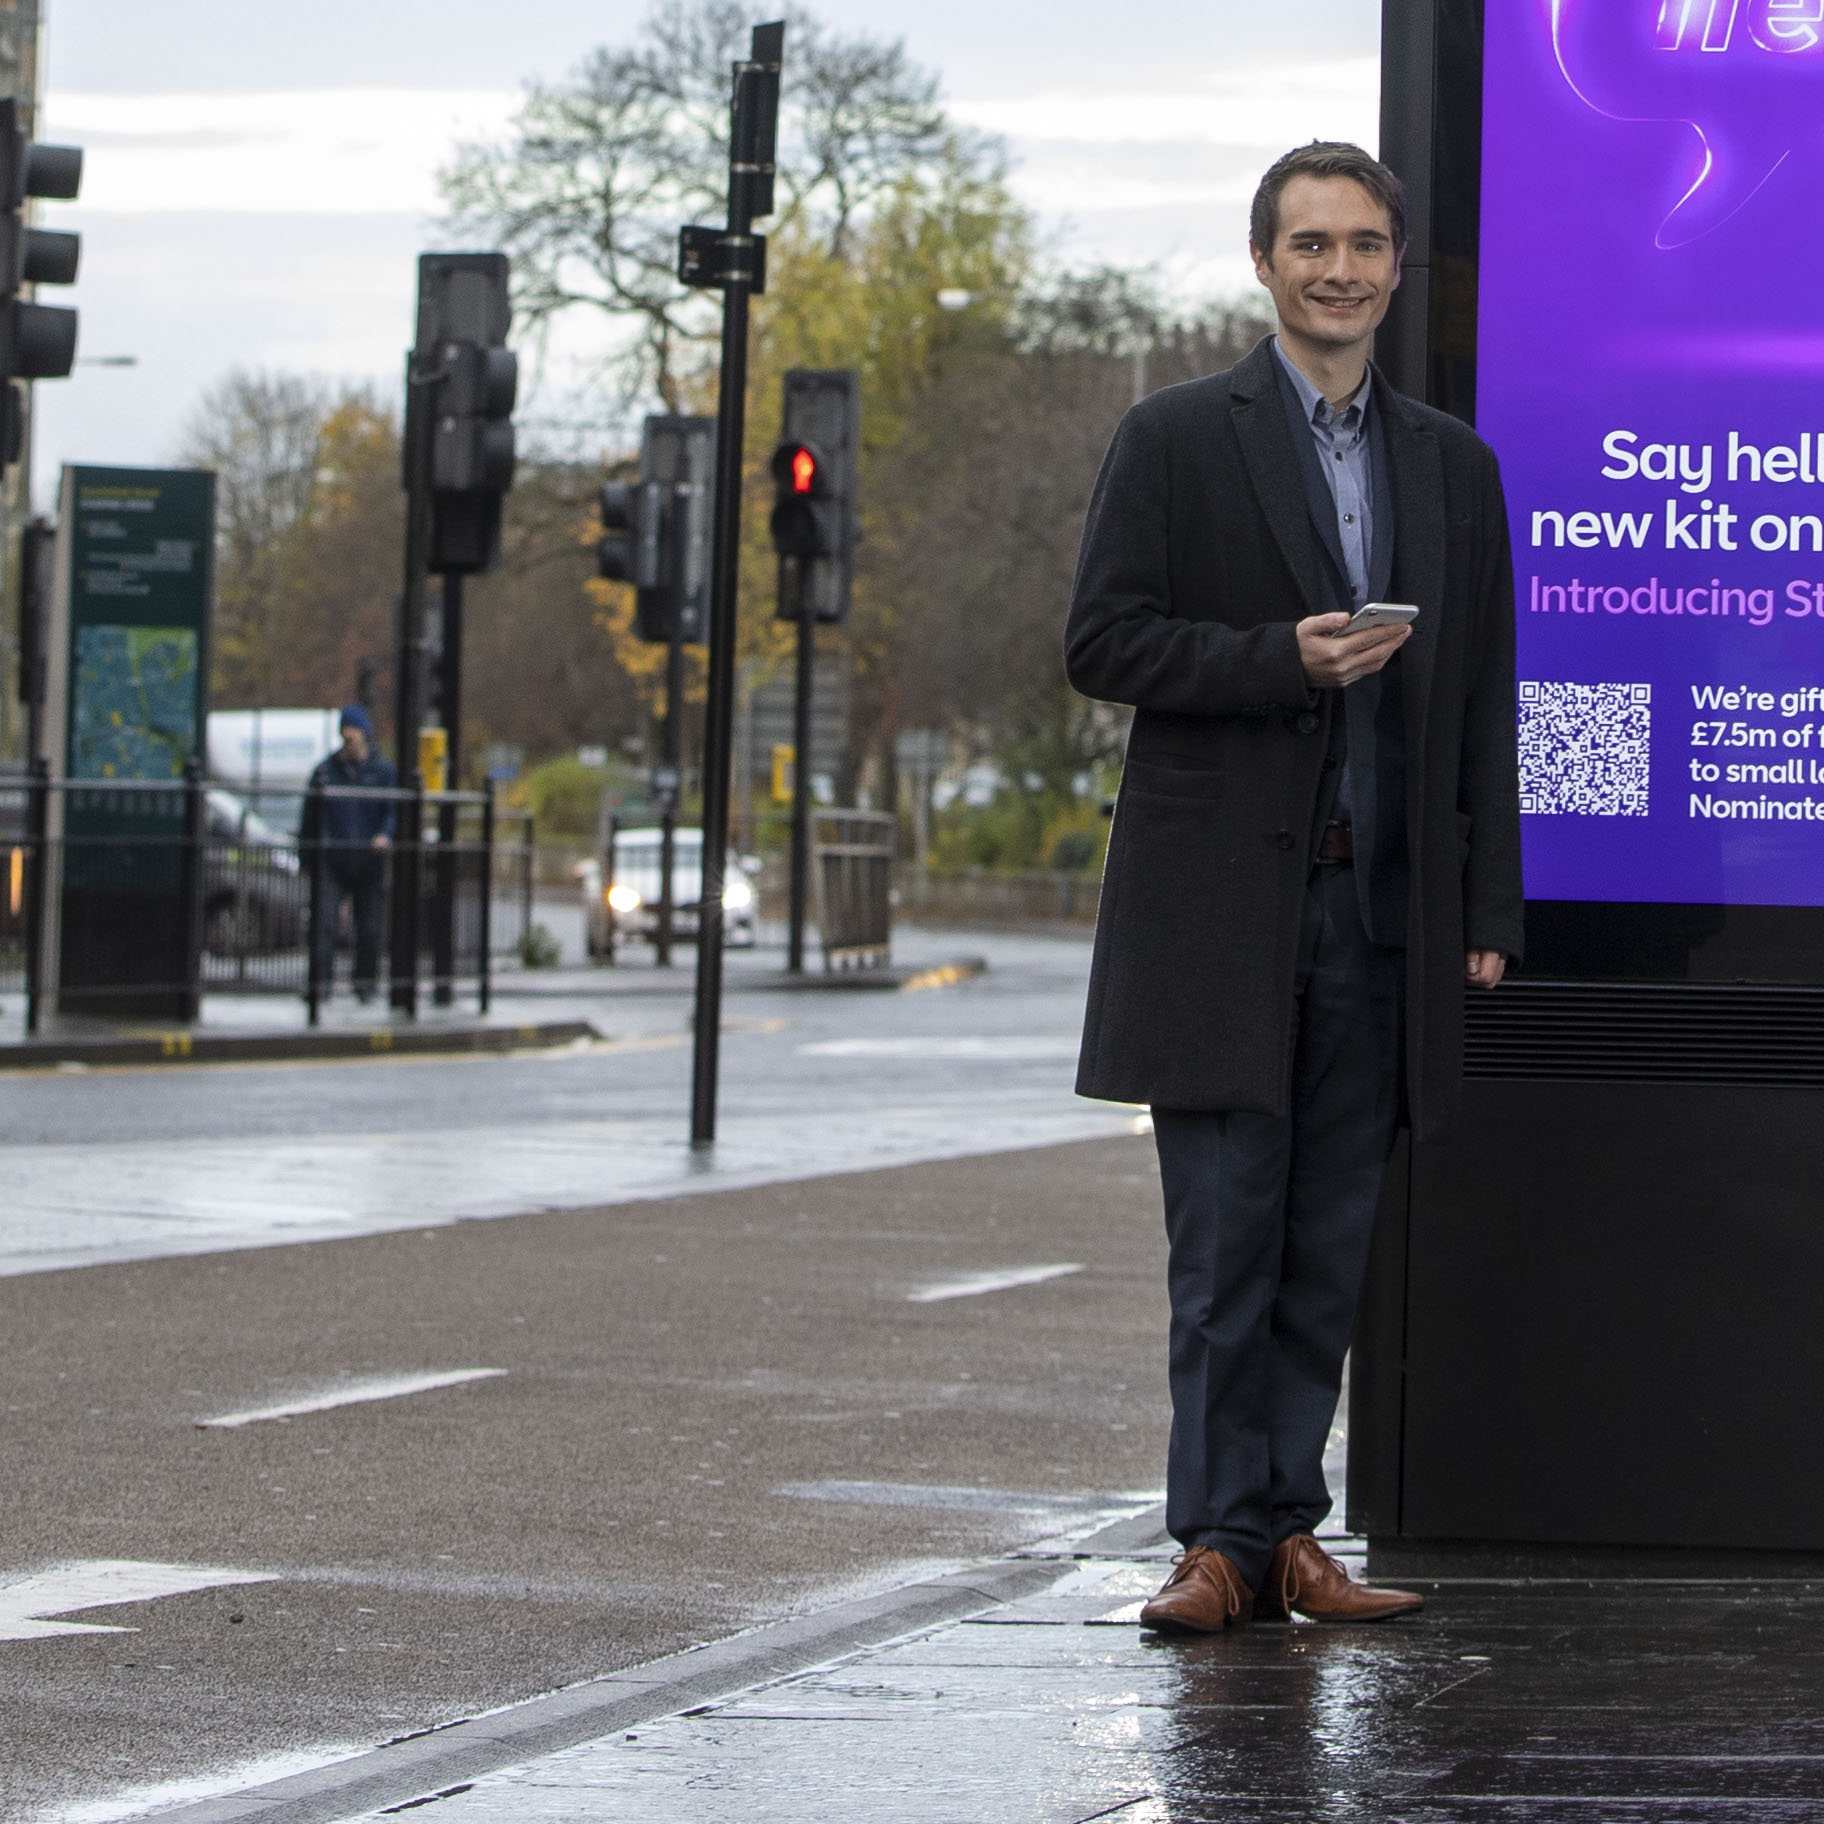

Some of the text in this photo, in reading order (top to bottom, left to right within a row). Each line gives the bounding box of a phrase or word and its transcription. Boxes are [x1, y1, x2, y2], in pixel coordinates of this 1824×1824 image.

[1602, 431, 1712, 493] Say
[1532, 511, 1653, 548] new
[1666, 500, 1737, 550] kit
[1751, 515, 1822, 551] on
[1532, 576, 1773, 625] Introducing
[1692, 686, 1774, 710] We’re
[1691, 722, 1776, 747] £7.5m
[1783, 724, 1813, 747] of
[1689, 759, 1719, 781] to
[1727, 759, 1804, 783] small
